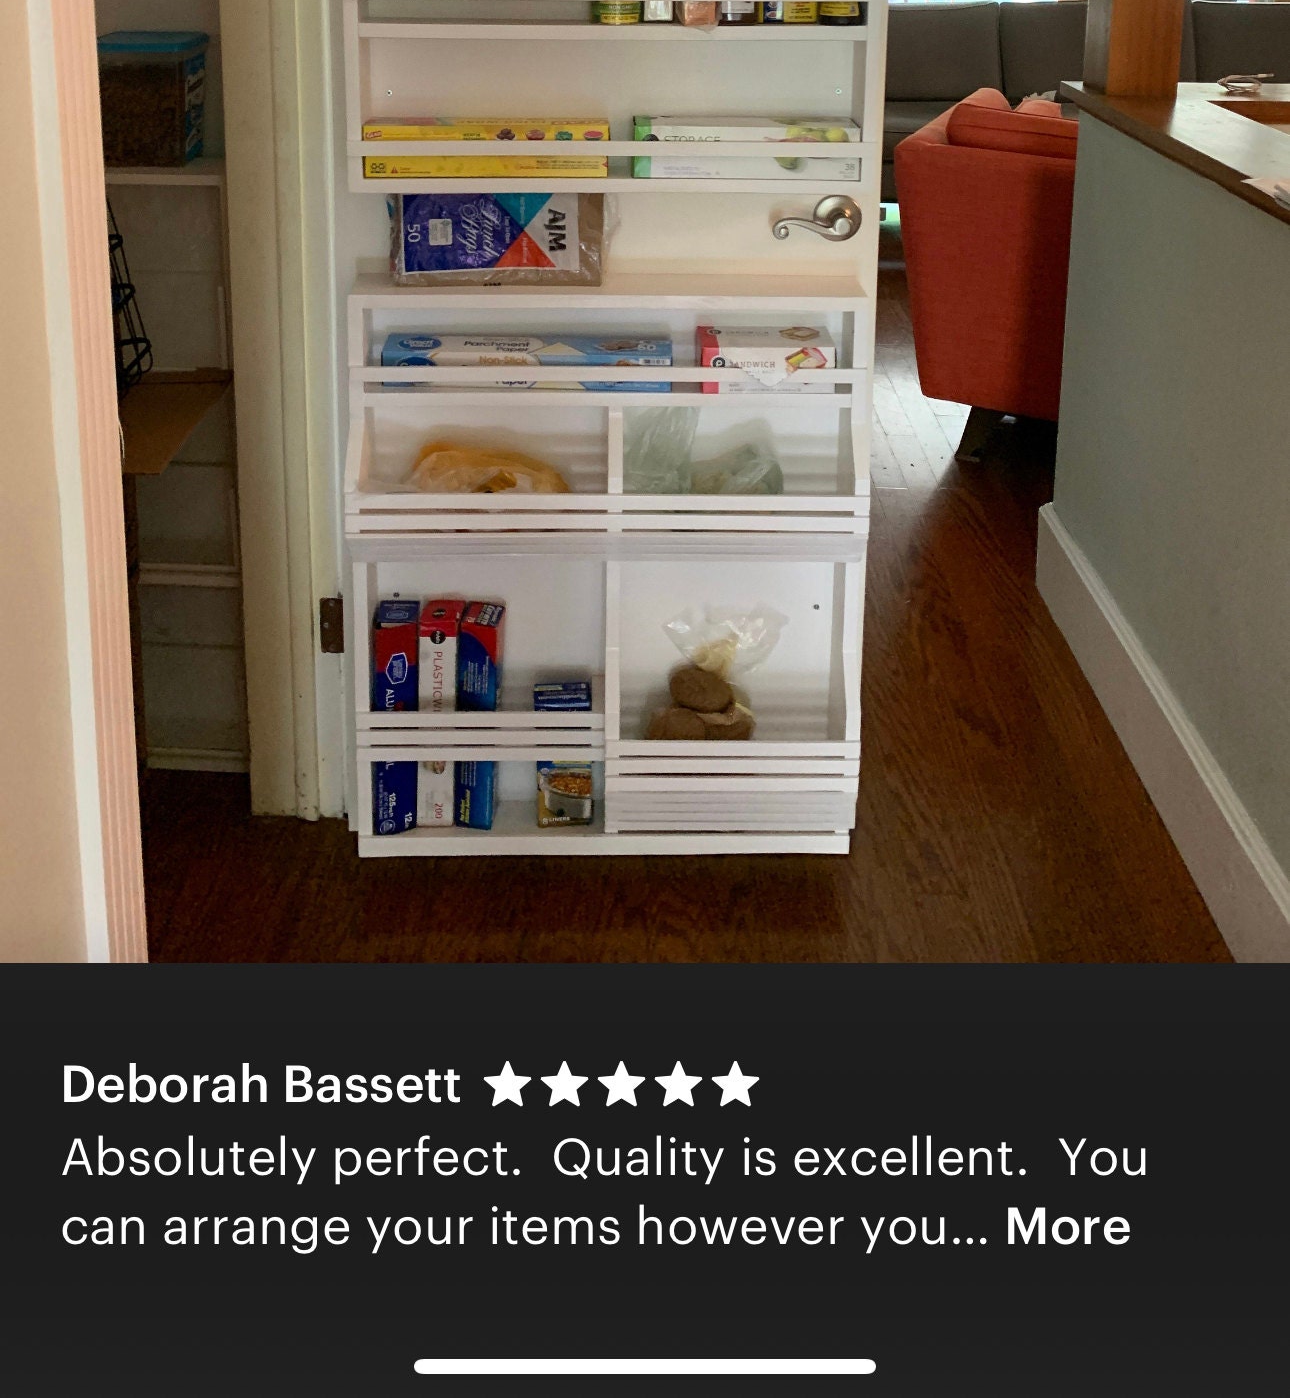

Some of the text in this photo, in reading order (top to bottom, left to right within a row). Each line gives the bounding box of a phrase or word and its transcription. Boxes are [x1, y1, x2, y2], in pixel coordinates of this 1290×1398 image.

[408, 223, 421, 243] 50
[544, 208, 567, 252] AJM
[464, 340, 530, 348] Parchment
[478, 355, 528, 365] Non-Stick
[434, 802, 444, 819] 200
